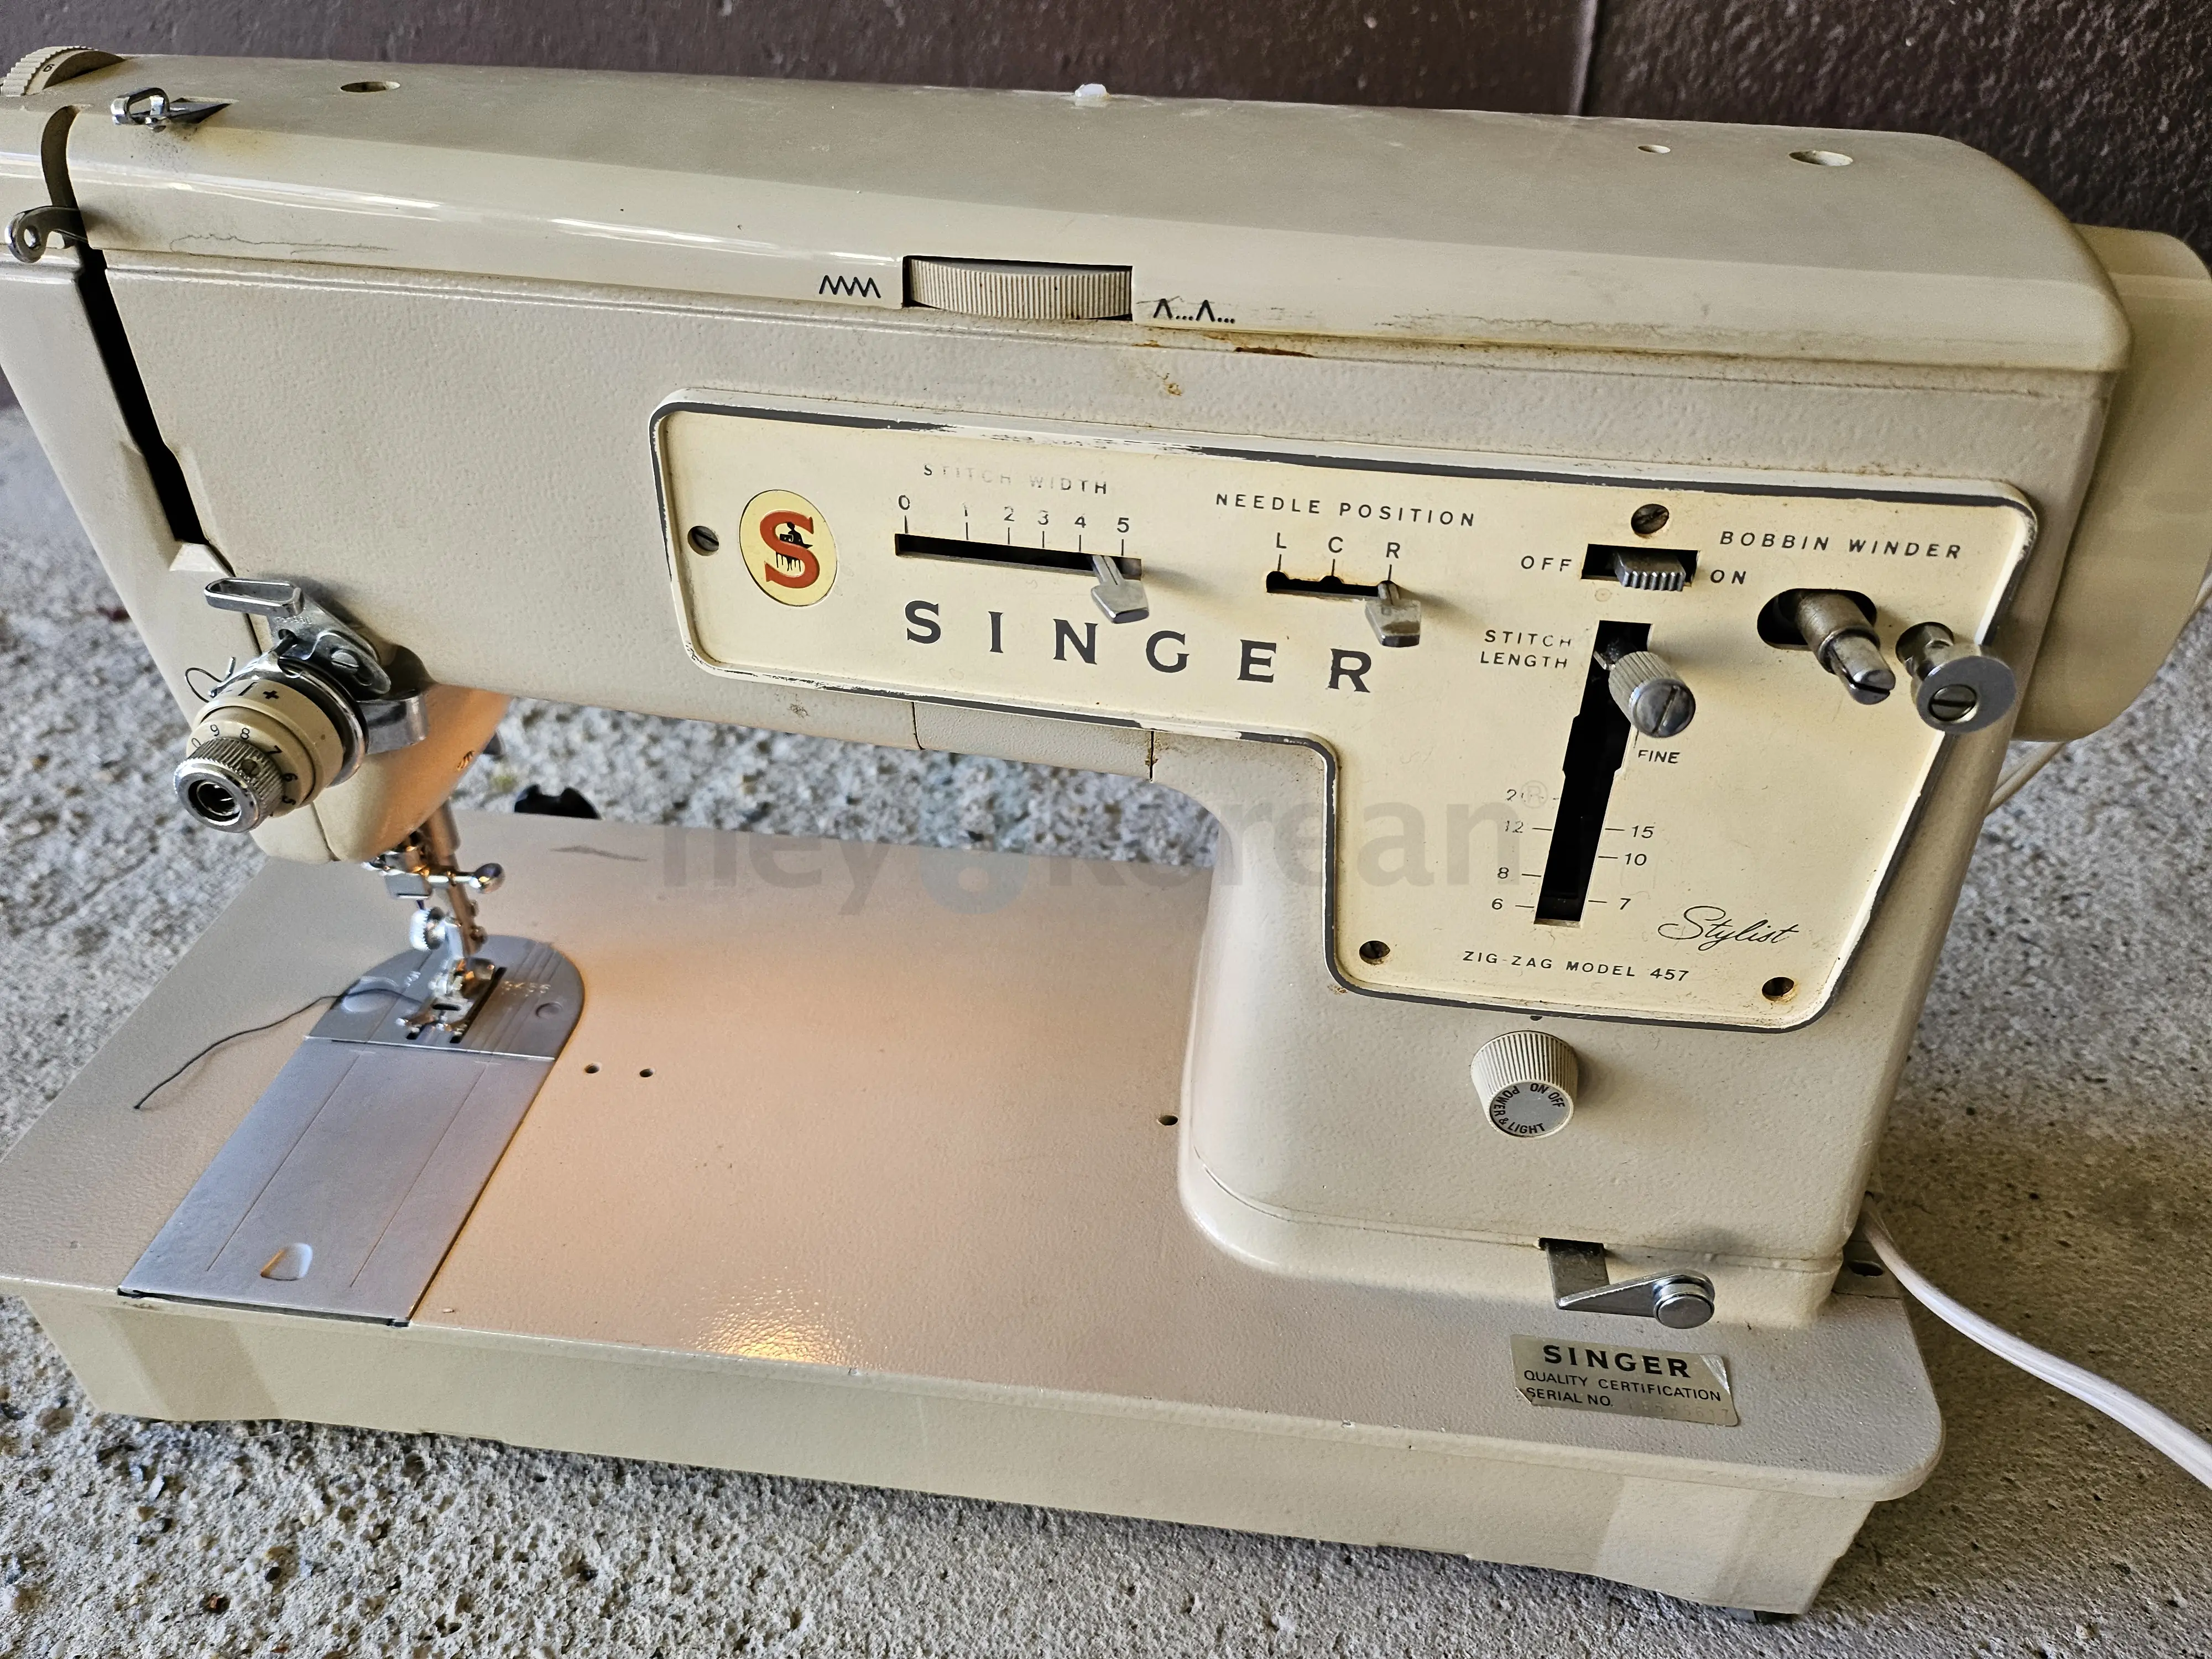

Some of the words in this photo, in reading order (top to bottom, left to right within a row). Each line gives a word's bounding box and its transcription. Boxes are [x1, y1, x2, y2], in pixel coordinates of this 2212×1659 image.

[924, 465, 1010, 483] STITCH
[1030, 476, 1106, 494] WIDTH
[899, 495, 910, 510] 0
[1004, 506, 1014, 521] 2
[1037, 510, 1048, 525] 3
[1074, 516, 1086, 528] 4
[1117, 518, 1129, 533] 5
[1217, 494, 1320, 514] NEEDLE
[1339, 503, 1473, 526] POSITION
[1276, 533, 1287, 549] L
[1328, 536, 1343, 553] C
[1386, 542, 1400, 559] R
[1720, 531, 1828, 551] BOBBIN
[1849, 539, 1960, 559] WINDER
[1521, 556, 1572, 572] OFF
[1710, 570, 1746, 585] ON
[905, 601, 1372, 693] SINGER
[1484, 630, 1571, 647] STITCH
[1480, 651, 1567, 669] LENGTH
[210, 724, 220, 737] 9
[239, 727, 251, 740] 8
[1638, 750, 1680, 764] FINE
[1505, 821, 1523, 833] 12
[1632, 826, 1655, 838] 15
[1625, 853, 1647, 865] 10
[1497, 867, 1509, 879] 8
[1492, 899, 1503, 910] 6
[1620, 898, 1631, 910] 7
[1658, 906, 1799, 951] Stylist
[1463, 951, 1552, 968] ZIG-ZAG
[1566, 961, 1635, 977] MODEL
[1650, 968, 1689, 981] 457
[1493, 1086, 1520, 1117] POWER
[1530, 1083, 1548, 1094] ON
[1548, 1092, 1566, 1108] OFF
[1499, 1117, 1509, 1125] &
[1508, 1121, 1545, 1134] LIGHT
[1543, 1344, 1691, 1378] SINGER
[1524, 1370, 1588, 1387] QUALITY
[1598, 1379, 1721, 1402] CERTIFICATION
[1526, 1387, 1583, 1404] SERIAL
[1587, 1395, 1614, 1407] NO.
